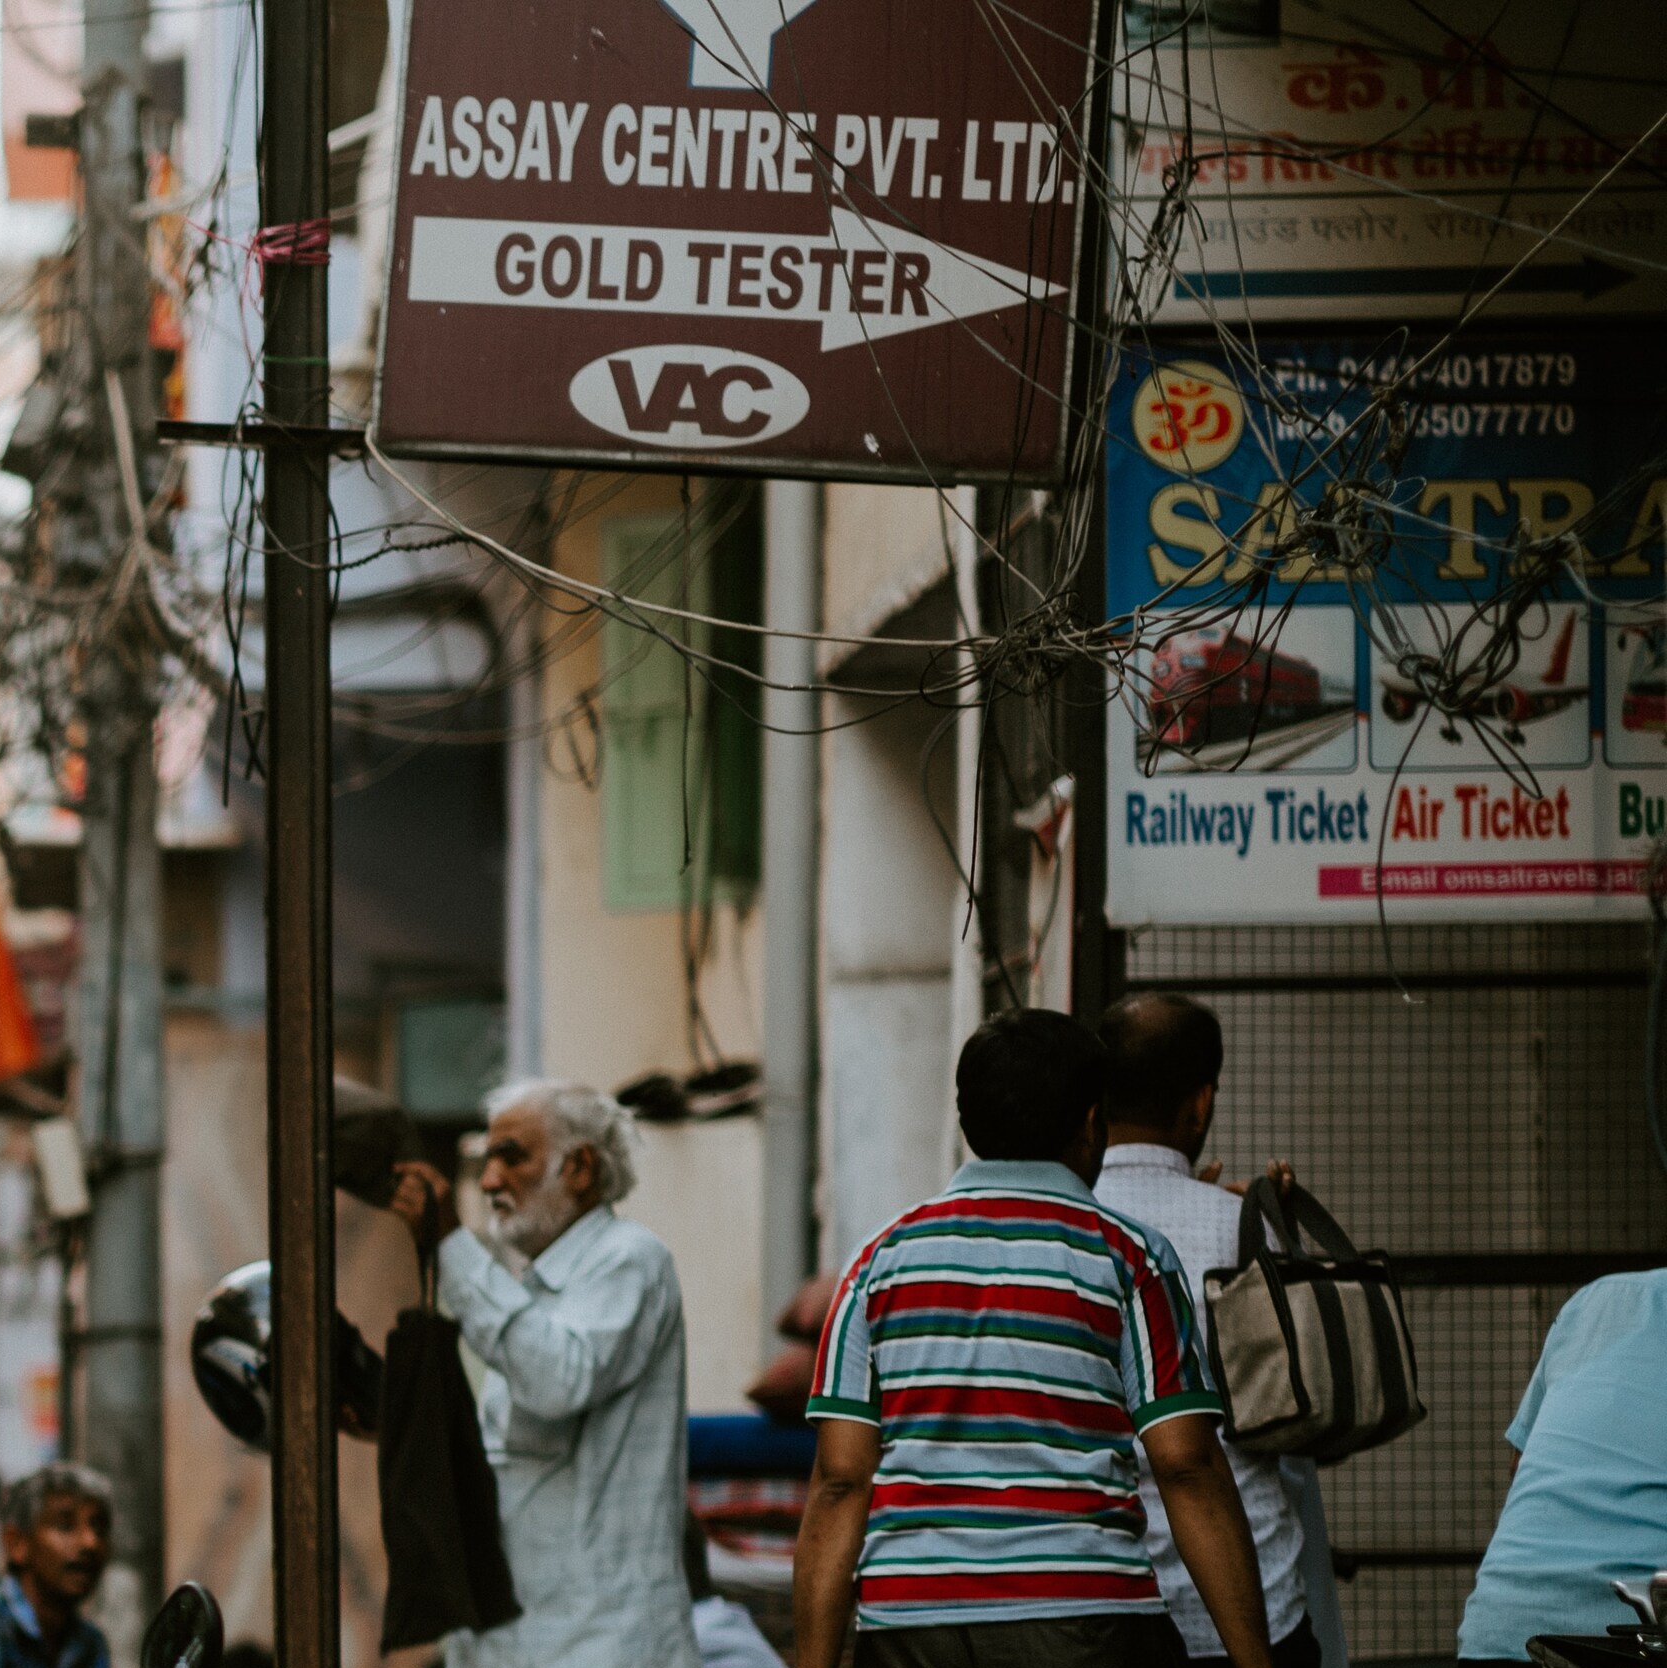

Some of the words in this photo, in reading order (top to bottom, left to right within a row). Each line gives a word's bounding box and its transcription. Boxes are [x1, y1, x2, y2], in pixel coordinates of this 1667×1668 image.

[410, 95, 589, 182] ASSAY
[601, 103, 816, 193] CENTRE
[832, 114, 942, 199] PVT.
[962, 119, 1075, 204] LTD.
[494, 233, 664, 301] GOLD
[687, 242, 931, 317] TESTER
[607, 358, 775, 438] VAC
[1147, 479, 1374, 587] SA
[1125, 790, 1255, 858] Railway
[1266, 788, 1369, 844] Ticket
[1391, 785, 1445, 840] Air
[1455, 781, 1570, 840] Ticket
